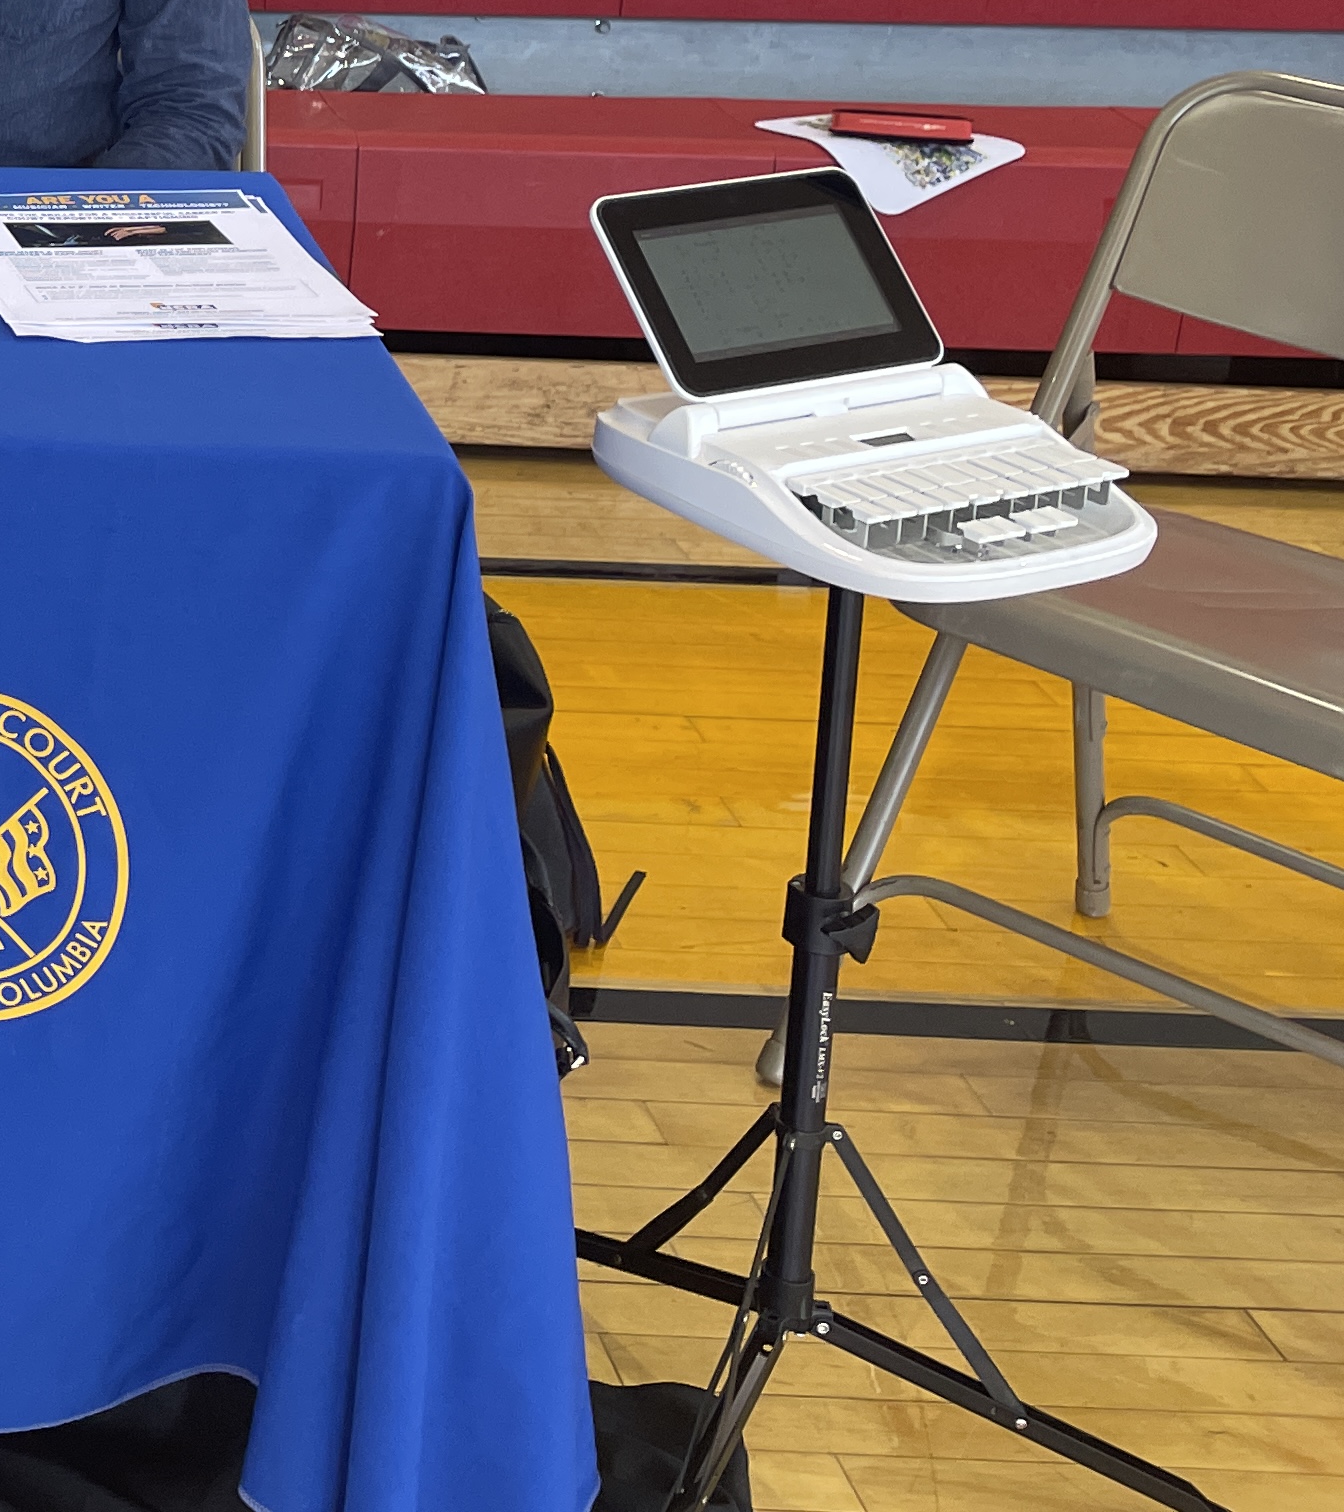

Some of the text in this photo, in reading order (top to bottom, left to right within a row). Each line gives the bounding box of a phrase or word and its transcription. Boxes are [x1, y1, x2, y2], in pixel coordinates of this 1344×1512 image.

[27, 193, 157, 205] ARE YOU A
[818, 991, 834, 1044] EasyLock
